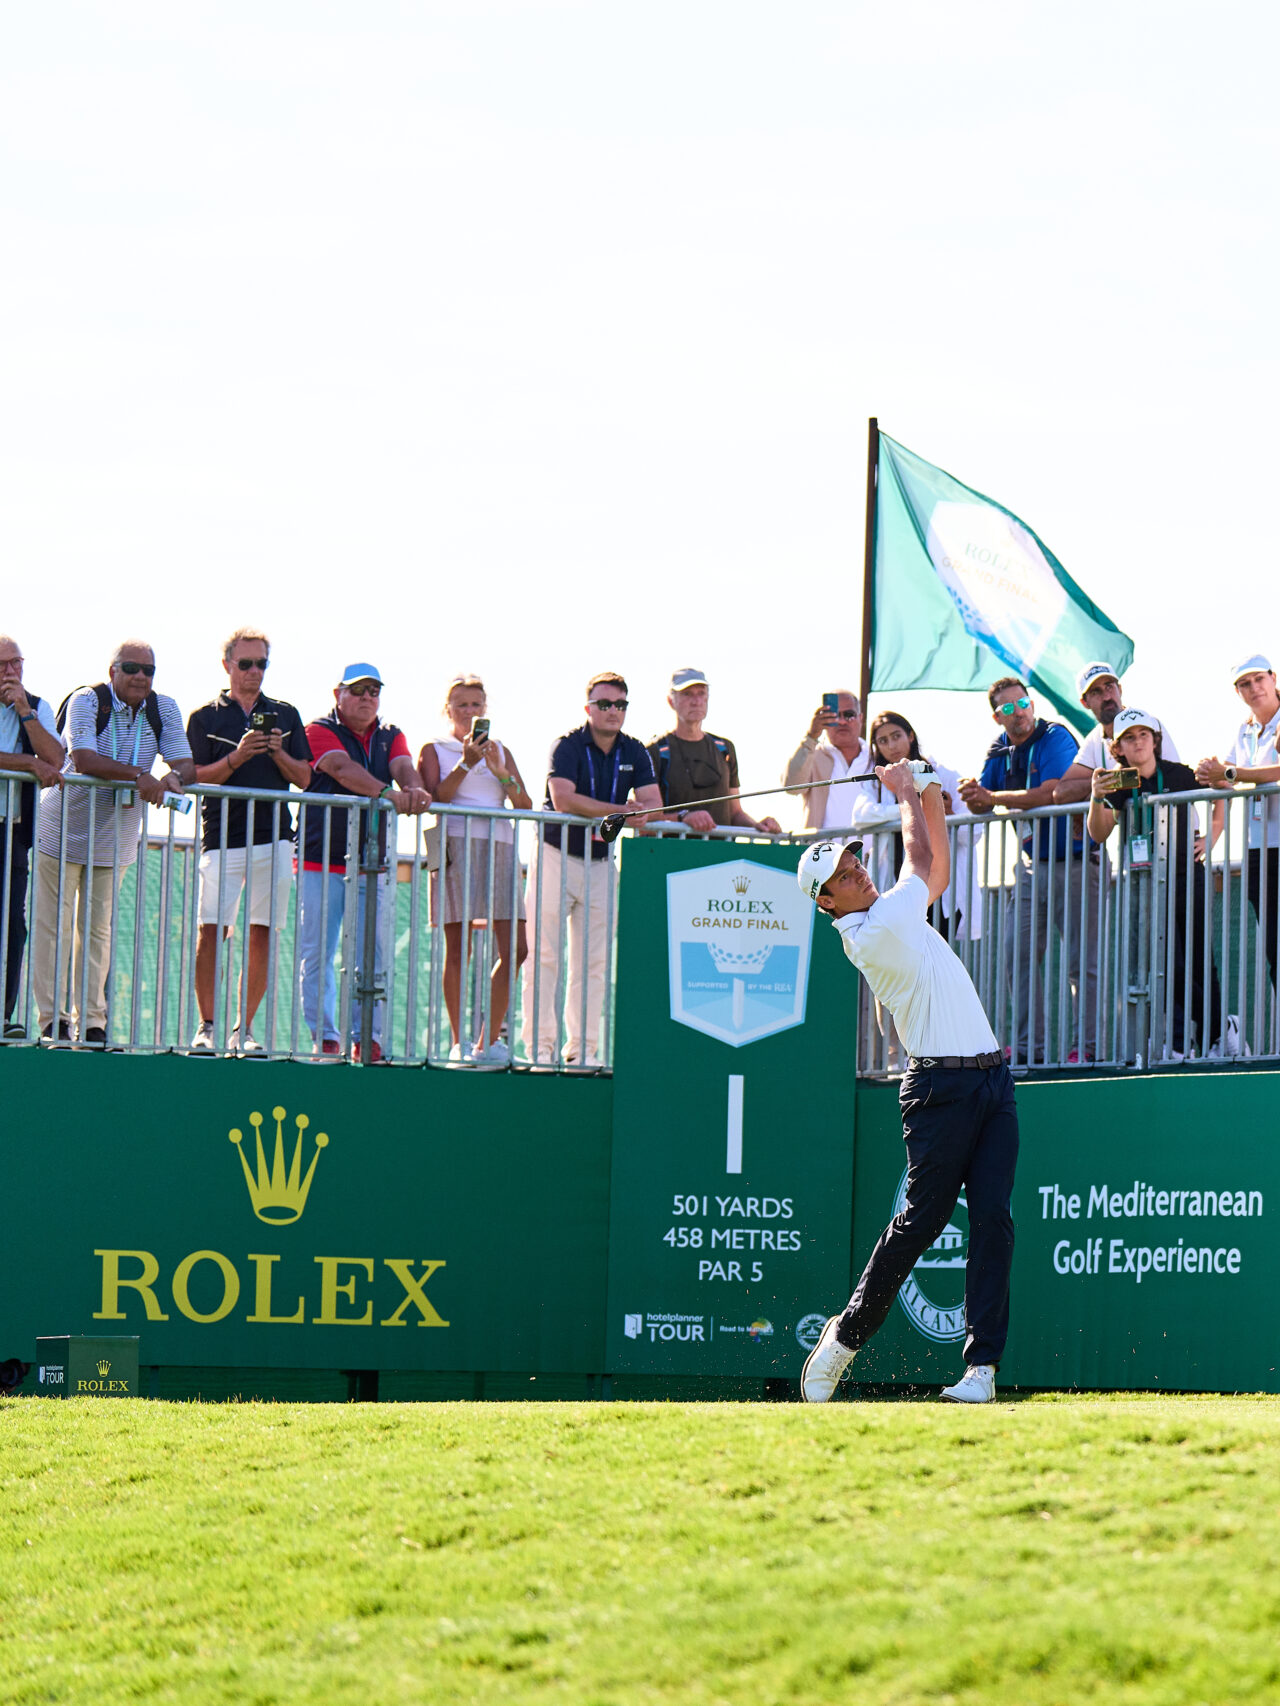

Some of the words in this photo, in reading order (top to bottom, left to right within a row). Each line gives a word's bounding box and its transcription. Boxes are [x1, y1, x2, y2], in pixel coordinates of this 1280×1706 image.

[707, 899, 774, 914] ROLEX
[691, 917, 743, 929] GRAND
[747, 919, 789, 931] FINAL
[672, 1195, 708, 1217] 501
[715, 1196, 794, 1219] YARDS
[1038, 1183, 1081, 1220] The
[1086, 1180, 1264, 1219] Mediterranean
[662, 1227, 704, 1248] 458
[711, 1229, 802, 1251] METRES
[699, 1260, 743, 1281] PAR
[750, 1262, 764, 1282] 5
[1053, 1237, 1103, 1275] Golf
[1108, 1238, 1241, 1284] Experience
[92, 1248, 450, 1328] ROLEX
[902, 1279, 966, 1333] ALCANA
[646, 1313, 704, 1323] hotelplanner
[646, 1323, 705, 1343] TOUR
[46, 1372, 64, 1384] TOUR
[77, 1380, 129, 1391] ROLEX
